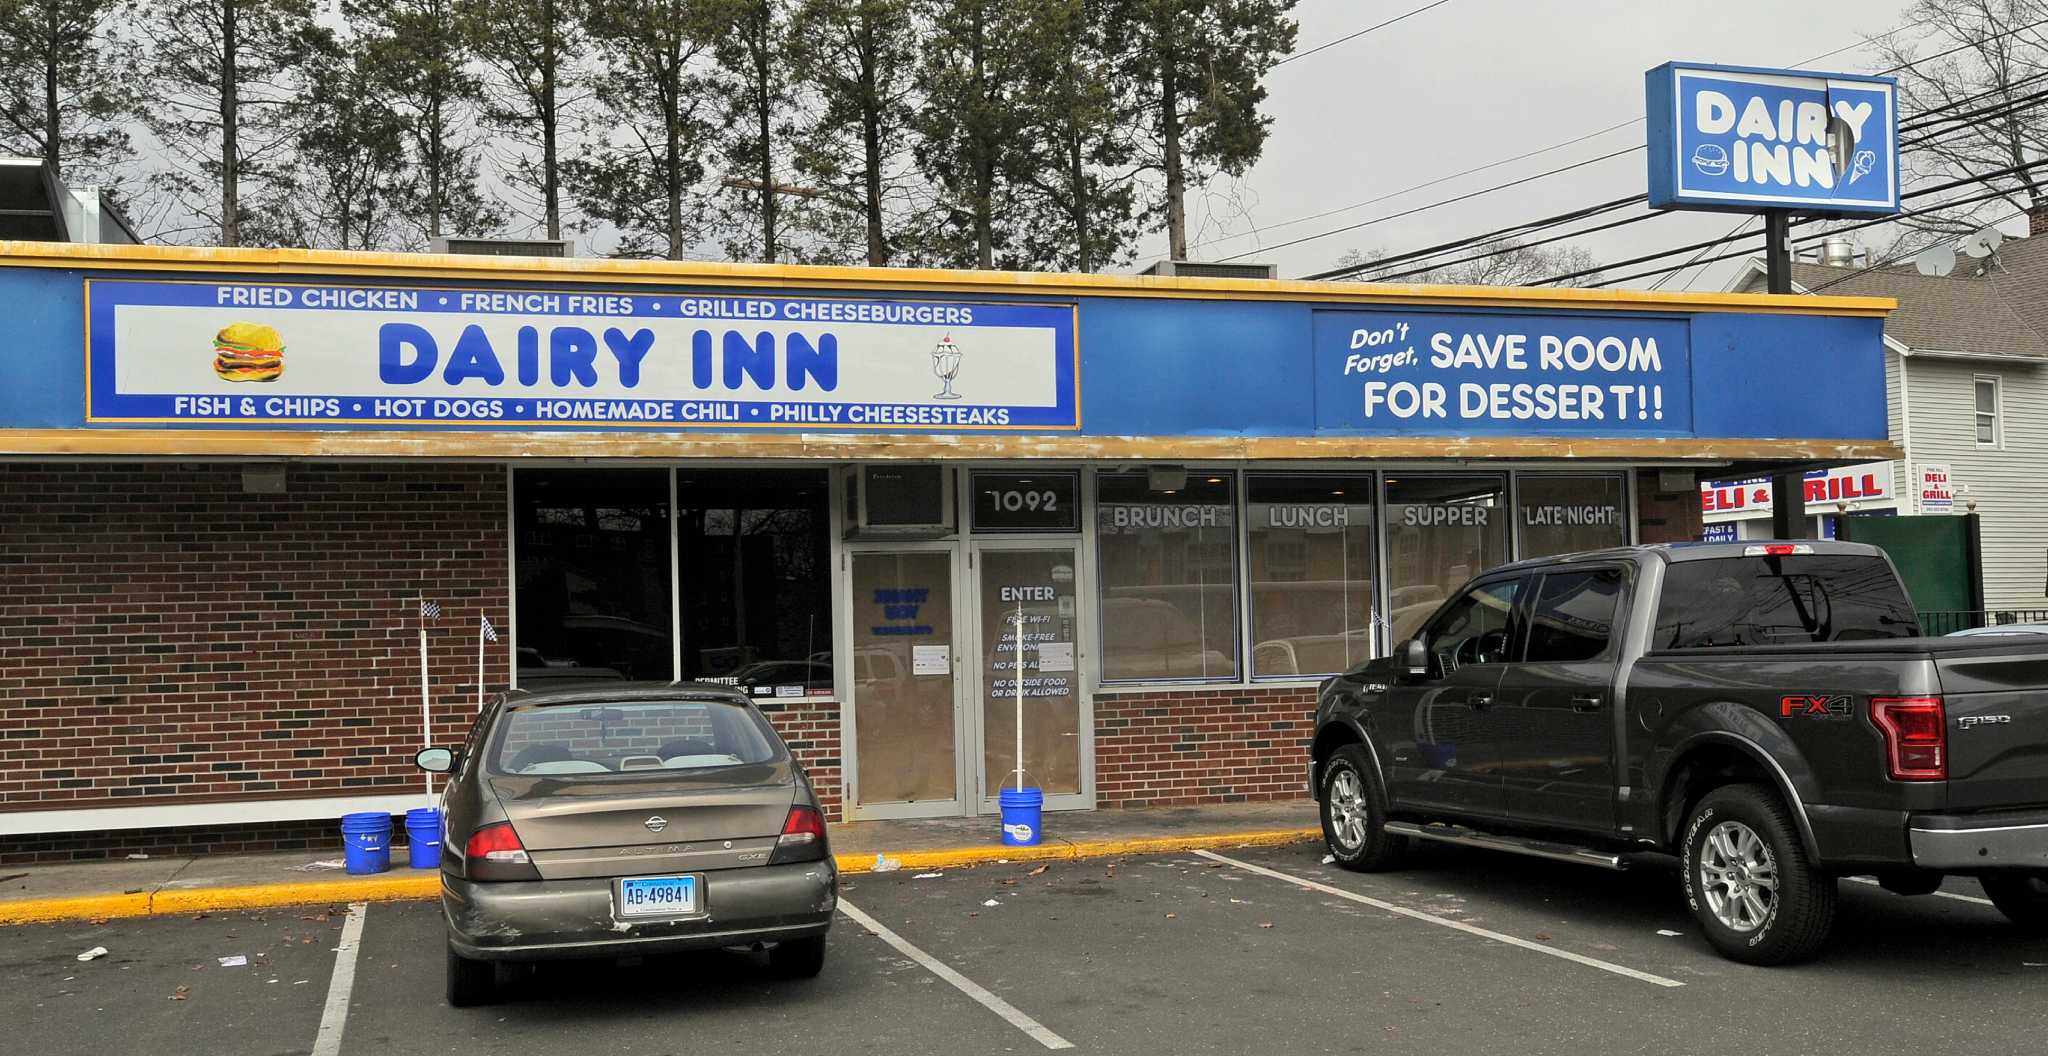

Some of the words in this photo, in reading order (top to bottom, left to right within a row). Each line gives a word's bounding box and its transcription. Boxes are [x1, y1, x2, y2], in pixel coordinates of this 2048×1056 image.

[1696, 90, 1872, 146] DAIRY
[1733, 139, 1835, 189] INN
[216, 286, 293, 307] FRIED
[301, 287, 419, 311] CHICKEN
[460, 293, 561, 314] FRENCH
[568, 296, 634, 316] FRIES
[680, 298, 777, 319] GRILLED
[783, 302, 974, 325] CHEESEBURGERS
[1350, 321, 1410, 350] Don't
[378, 322, 656, 389] DAIRY
[691, 329, 839, 393] INN
[1430, 332, 1527, 370] SAVE
[1539, 335, 1662, 373] ROOM
[174, 396, 231, 416] FISH
[240, 397, 257, 416] &
[263, 396, 341, 418] CHIPS
[374, 398, 426, 418] HOT
[433, 399, 504, 419] DOGS
[535, 401, 674, 421] HOMEMADE
[681, 402, 740, 422] CHILI
[1364, 381, 1447, 419] FOR
[1459, 382, 1663, 421] DESSERT!!
[769, 403, 844, 423] PHILLY
[847, 404, 1011, 426] CHEESESTEAKS
[1925, 473, 1947, 482] DELI
[992, 490, 1057, 512] 1092
[1702, 487, 1745, 512] ELI
[1752, 489, 1770, 504] &
[1803, 474, 1883, 503] RILL
[1922, 490, 1951, 499] GRILL
[1113, 506, 1217, 528] BRUNCH
[1269, 506, 1350, 527] LUNCH
[1404, 506, 1488, 528] SUPPER
[1526, 506, 1563, 526] LATE
[1567, 505, 1614, 525] NIGHT
[1001, 586, 1055, 601] ENTER
[1029, 615, 1051, 623] WI-FI
[993, 661, 1006, 670] NO
[1008, 660, 1028, 669] PES
[991, 690, 1004, 698] OR
[1031, 687, 1070, 697] ALLOWED
[993, 679, 1006, 688] NO
[1043, 678, 1067, 687] FOOD
[1780, 694, 1854, 718] FX4
